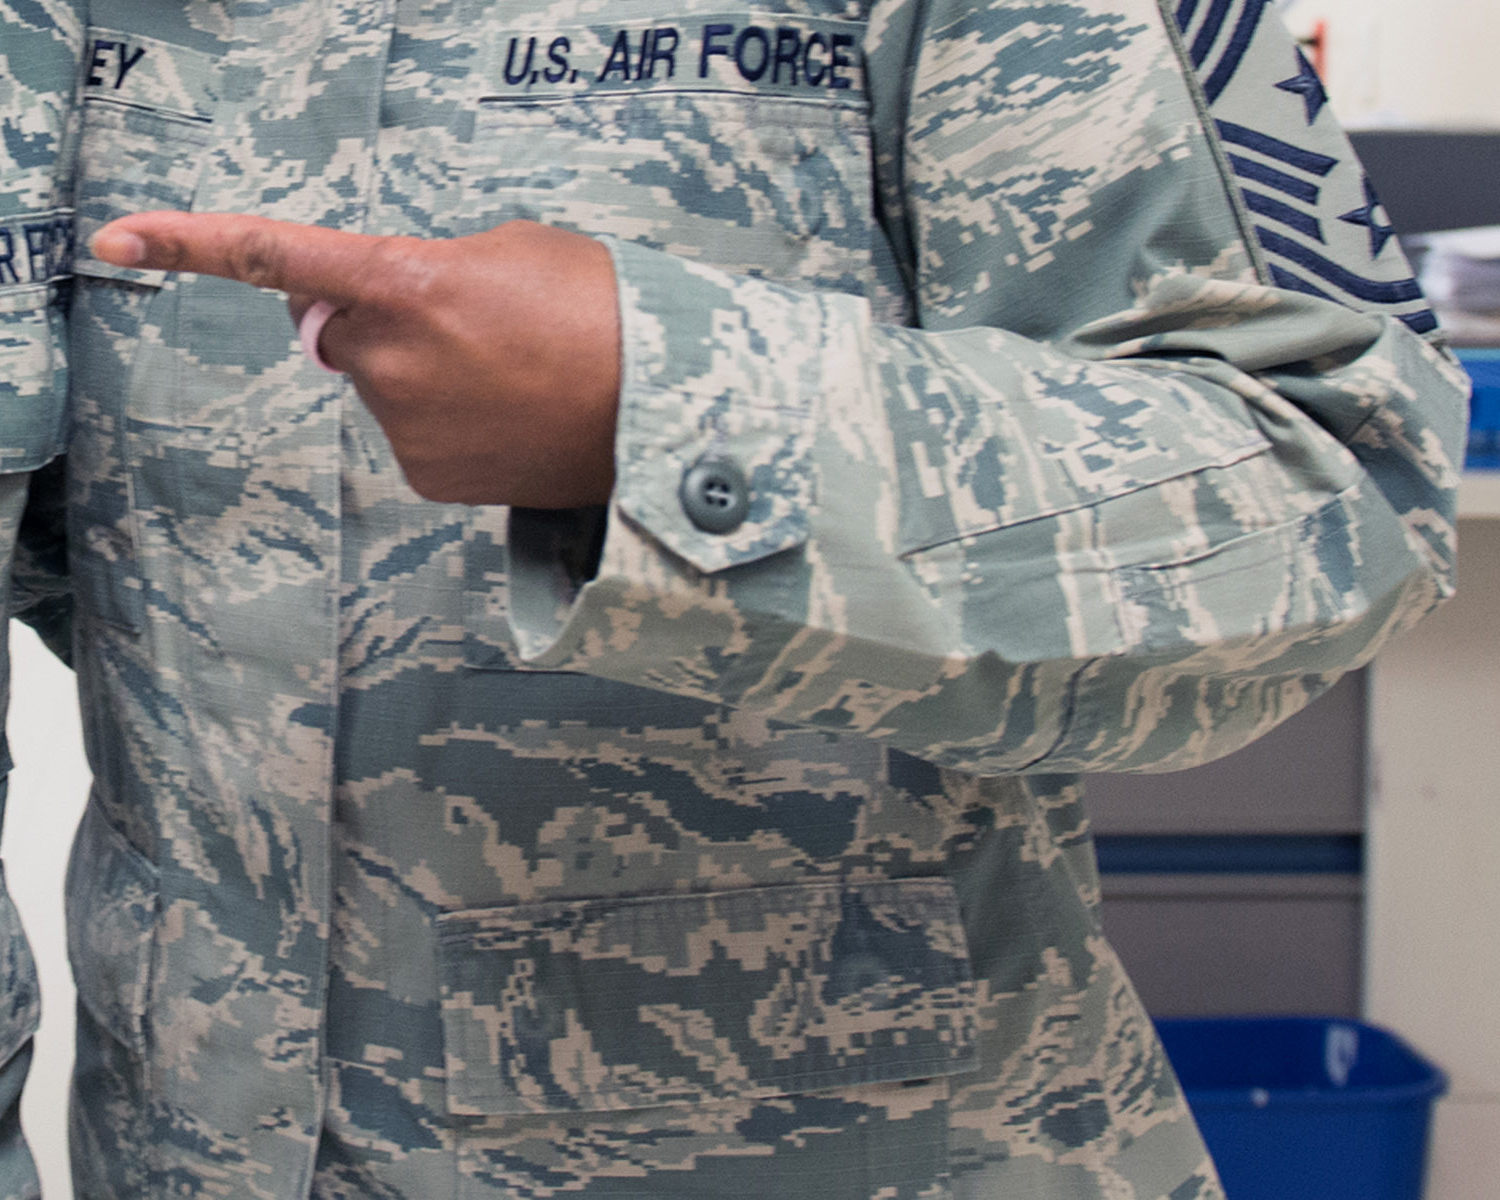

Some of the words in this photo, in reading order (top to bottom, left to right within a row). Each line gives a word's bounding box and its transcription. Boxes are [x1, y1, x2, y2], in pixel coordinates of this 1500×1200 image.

[504, 36, 579, 86] U.S.
[596, 27, 680, 83] AIR
[700, 23, 855, 90] FORCE
